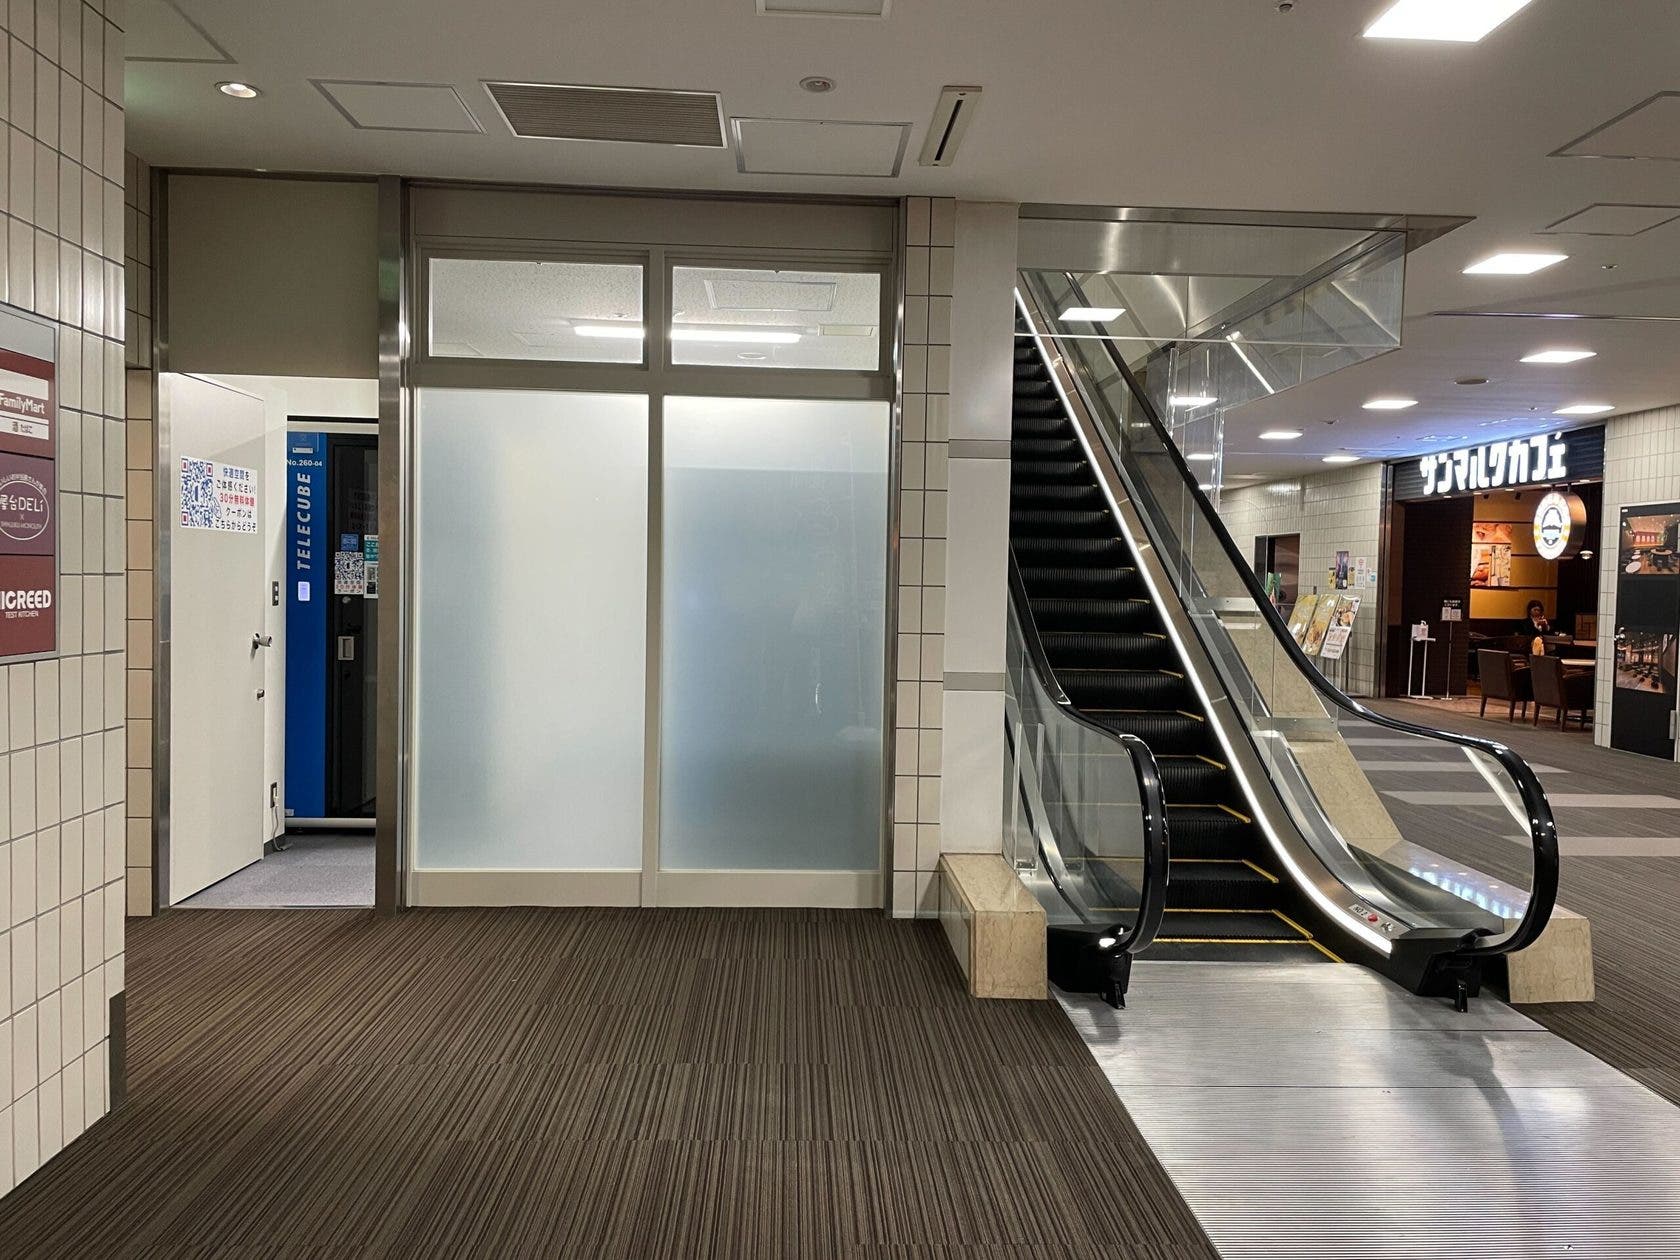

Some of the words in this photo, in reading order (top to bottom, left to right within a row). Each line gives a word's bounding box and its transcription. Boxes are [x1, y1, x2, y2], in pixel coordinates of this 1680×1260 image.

[1419, 431, 1567, 496] サンマルクカフェ
[296, 472, 311, 570] TELECUBE
